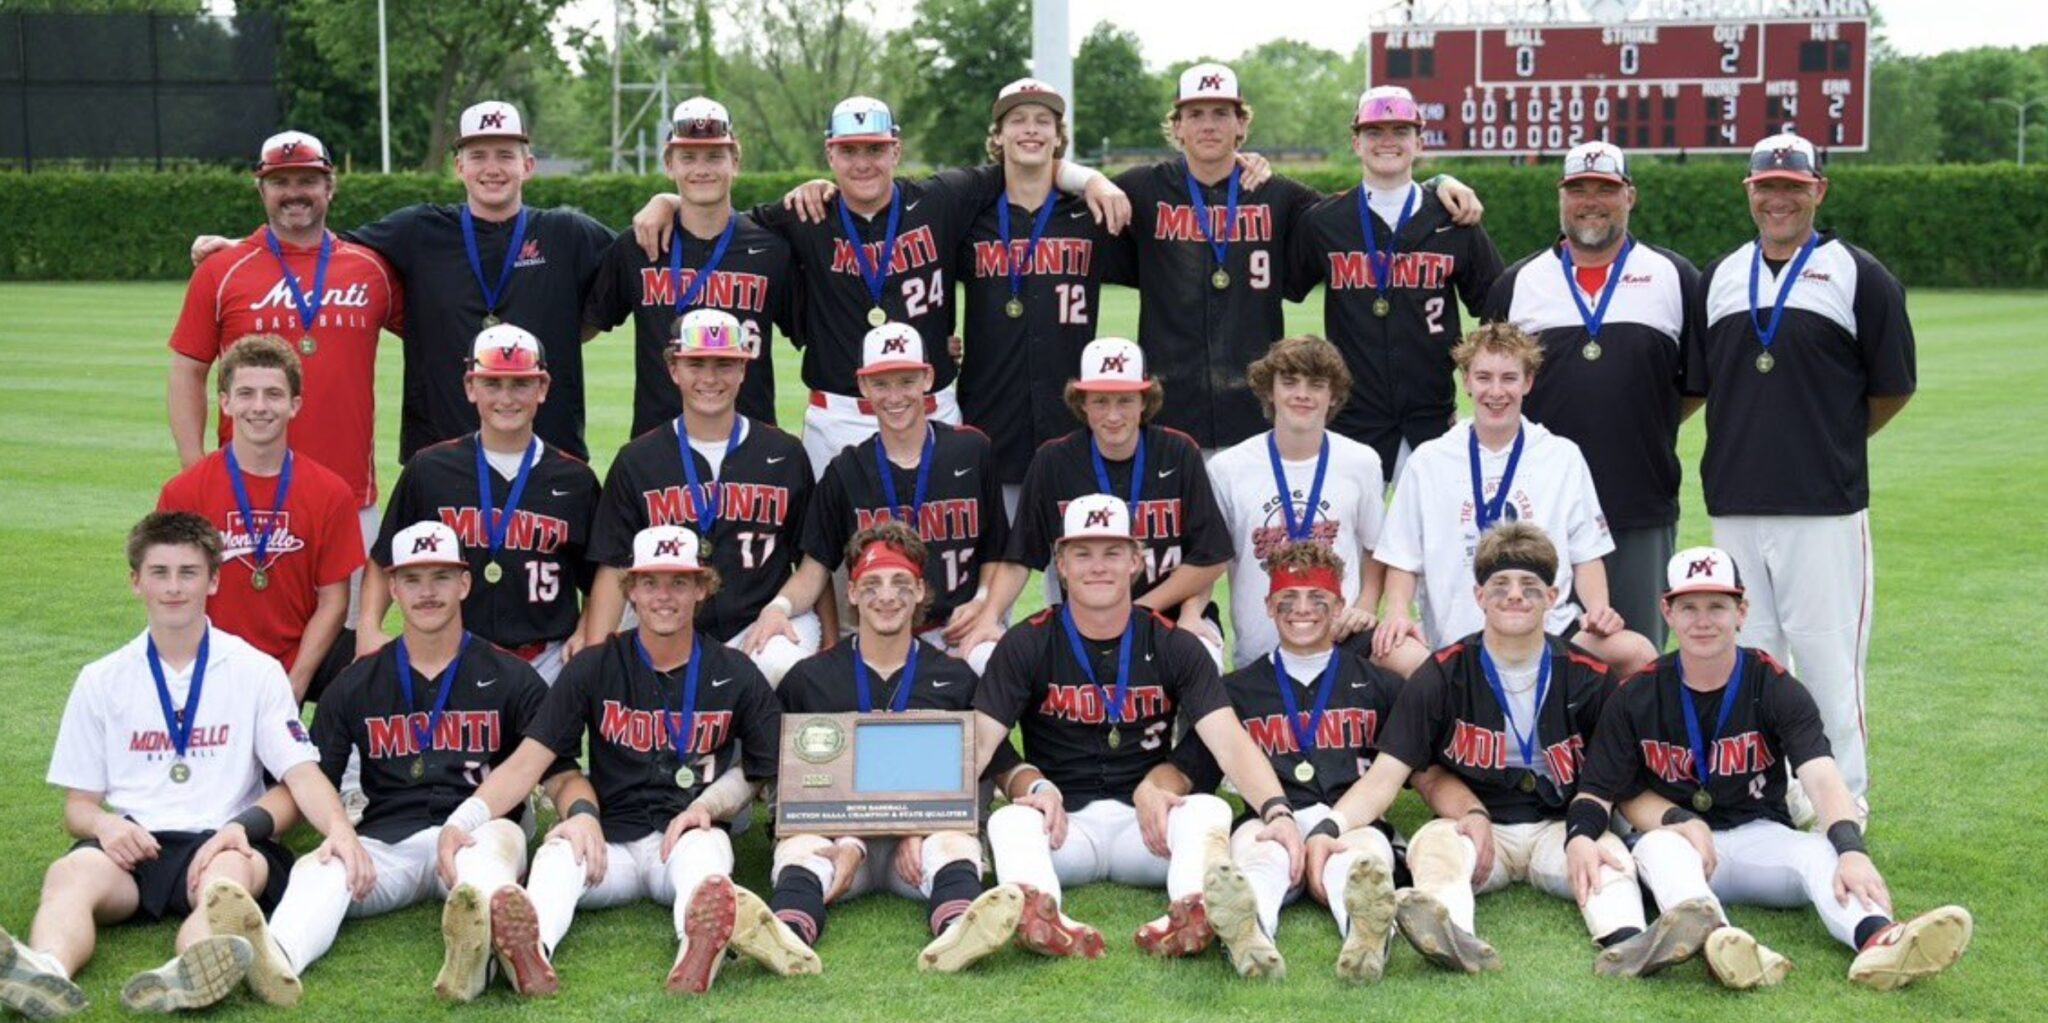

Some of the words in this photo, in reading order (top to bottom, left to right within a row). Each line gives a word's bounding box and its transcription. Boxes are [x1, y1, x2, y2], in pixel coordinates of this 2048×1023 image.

[1505, 28, 1545, 47] BALL
[1602, 26, 1658, 45] STRIKE
[1713, 24, 1747, 42] OUT
[1516, 45, 1534, 77] 0
[1620, 44, 1639, 75] 0
[1720, 43, 1740, 73] 2
[1249, 249, 1271, 289] 9
[901, 267, 944, 318] 24
[1055, 283, 1088, 324] 12
[255, 313, 366, 331] BASBALL
[1425, 297, 1444, 334] 2
[737, 532, 776, 568] 17
[525, 561, 560, 603] 15
[129, 724, 230, 752] MONELLO
